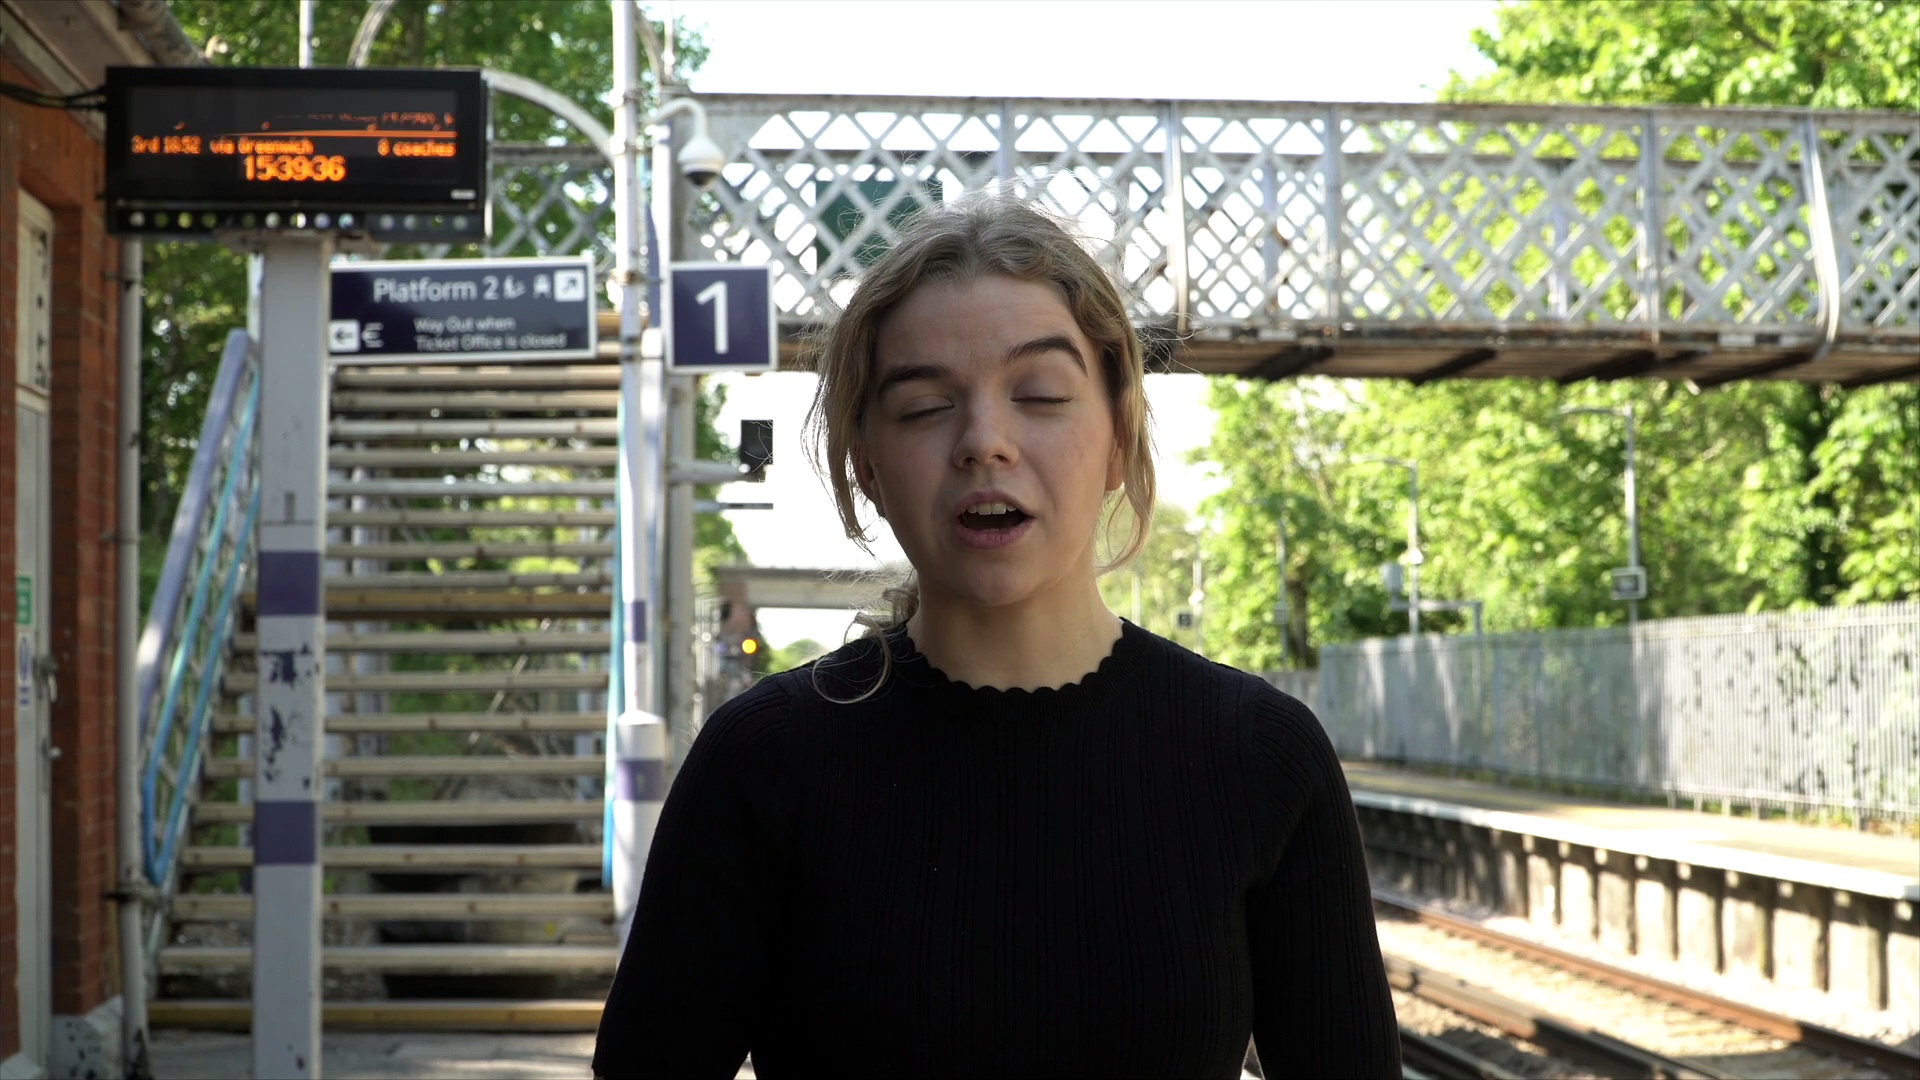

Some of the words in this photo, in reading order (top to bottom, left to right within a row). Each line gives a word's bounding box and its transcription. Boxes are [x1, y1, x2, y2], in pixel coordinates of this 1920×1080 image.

[210, 136, 235, 154] via
[237, 135, 314, 154] Greenwich
[391, 138, 456, 157] coaches
[372, 276, 478, 304] Platform
[482, 275, 499, 300] 2
[413, 317, 443, 335] Way
[446, 315, 475, 333] Out
[476, 315, 516, 331] when
[694, 280, 730, 355] 1
[415, 334, 459, 352] Ticket
[460, 333, 504, 351] Office
[505, 333, 519, 350] is
[519, 331, 568, 349] closed
